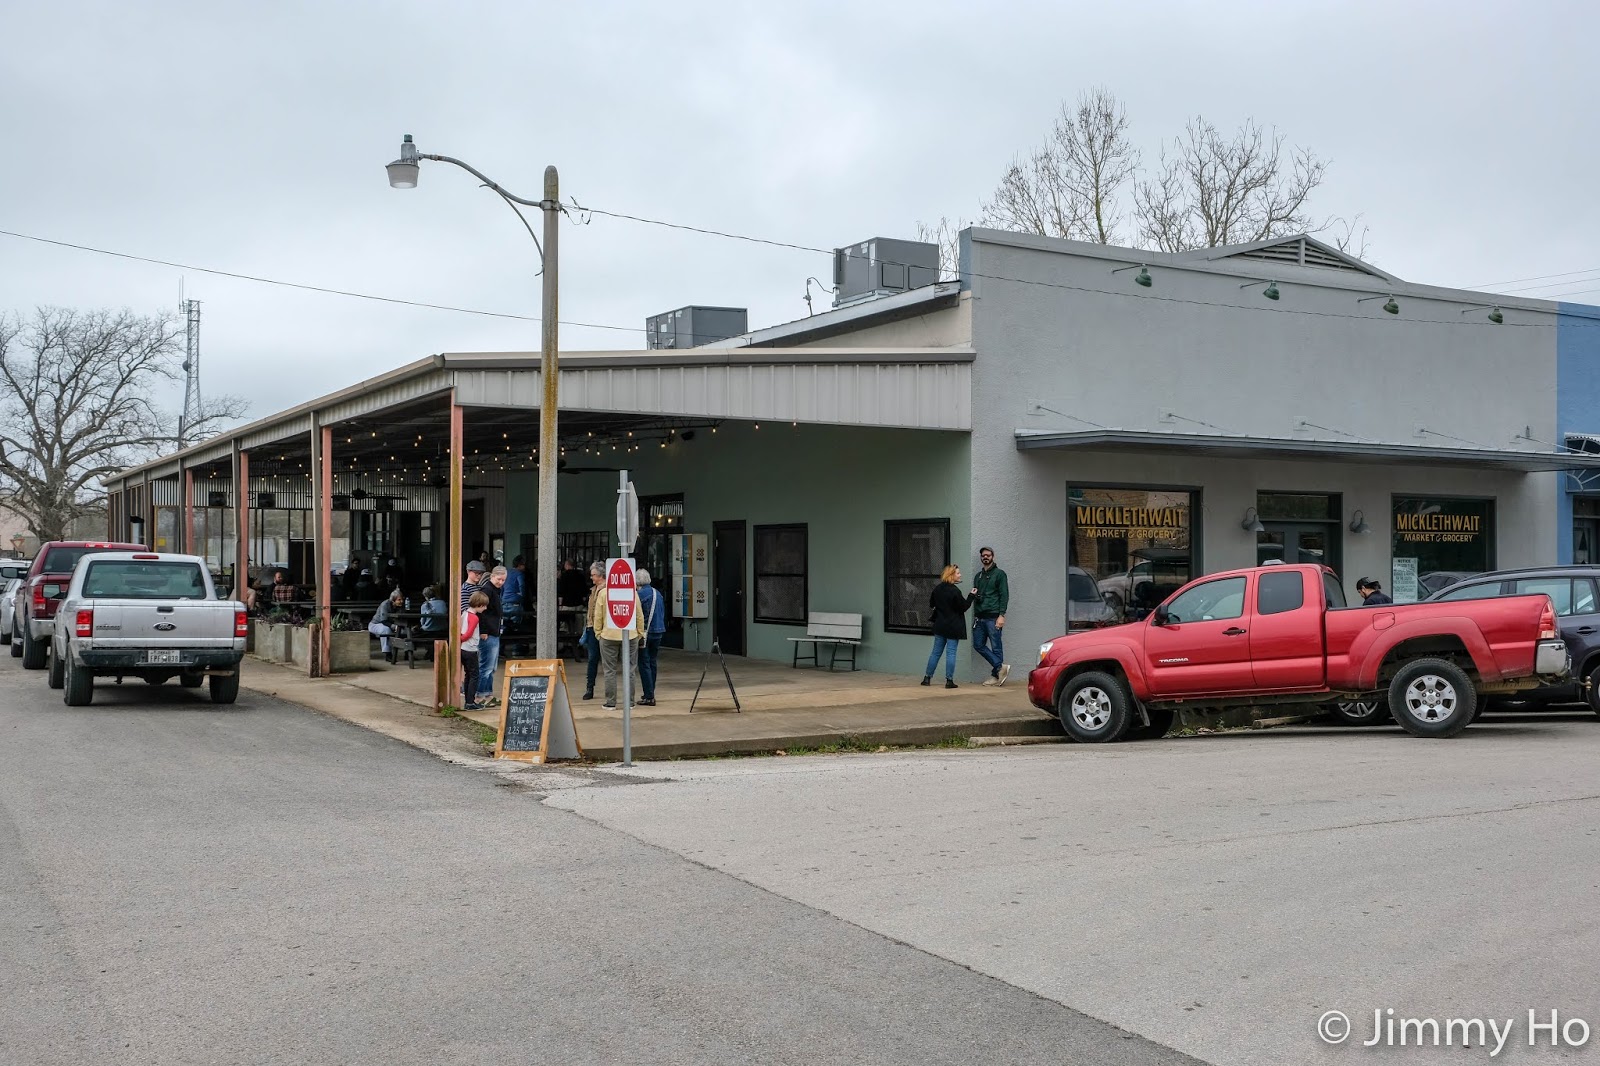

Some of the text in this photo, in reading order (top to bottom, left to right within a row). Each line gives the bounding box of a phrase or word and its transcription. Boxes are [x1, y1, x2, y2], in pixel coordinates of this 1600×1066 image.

[1076, 506, 1185, 526] MICKLETHWAIT
[1396, 513, 1480, 531] MICKLETHWAIT
[1086, 529, 1126, 538] MARKET
[1136, 529, 1175, 539] GROCERY
[1403, 533, 1435, 542] MARKET
[1442, 534, 1474, 543] GROCERY
[611, 573, 631, 585] DO NOT
[613, 604, 630, 616] ENTER
